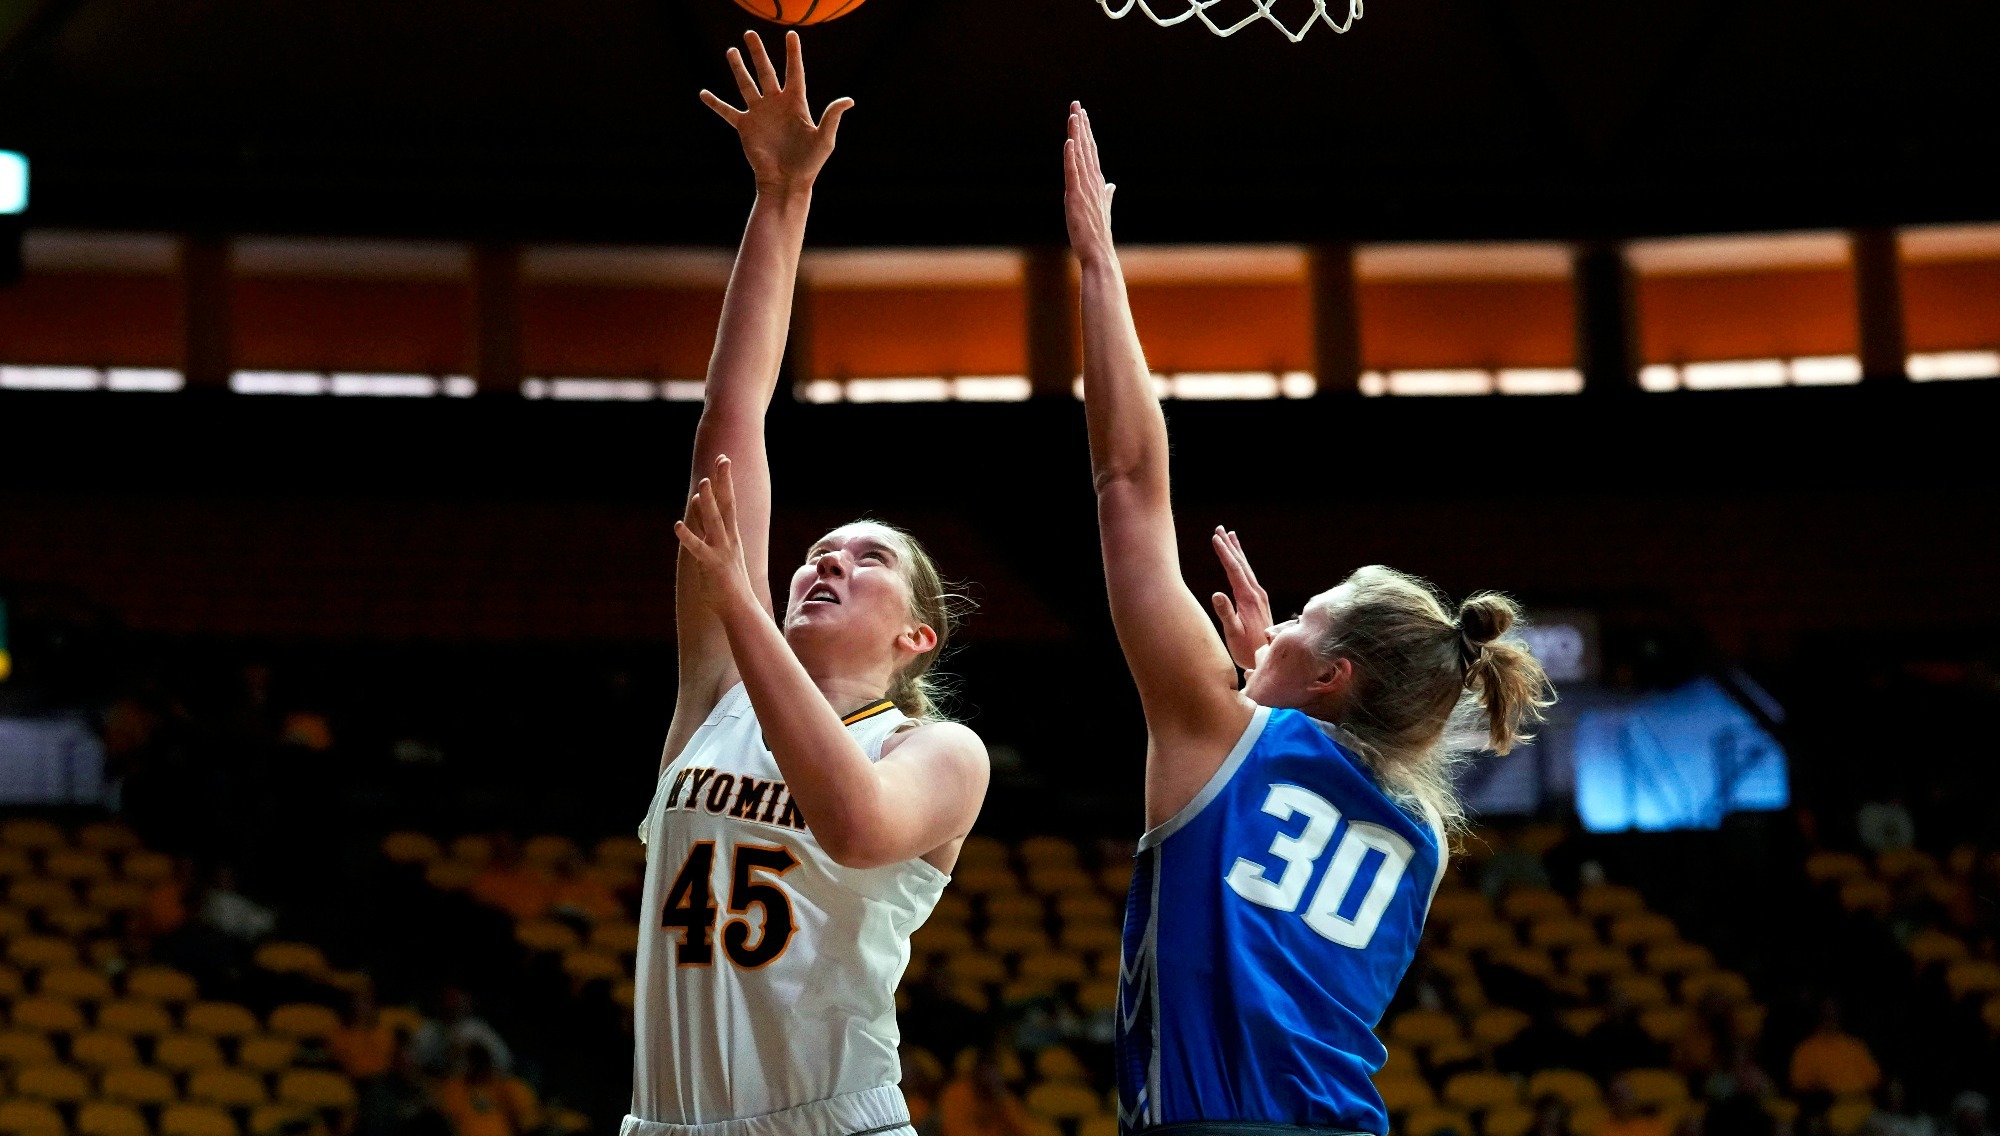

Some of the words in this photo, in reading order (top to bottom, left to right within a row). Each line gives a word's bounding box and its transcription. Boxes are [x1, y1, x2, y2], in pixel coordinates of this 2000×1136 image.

[665, 767, 807, 832] WYOMIN
[661, 840, 802, 969] 45
[1224, 783, 1416, 949] 30
